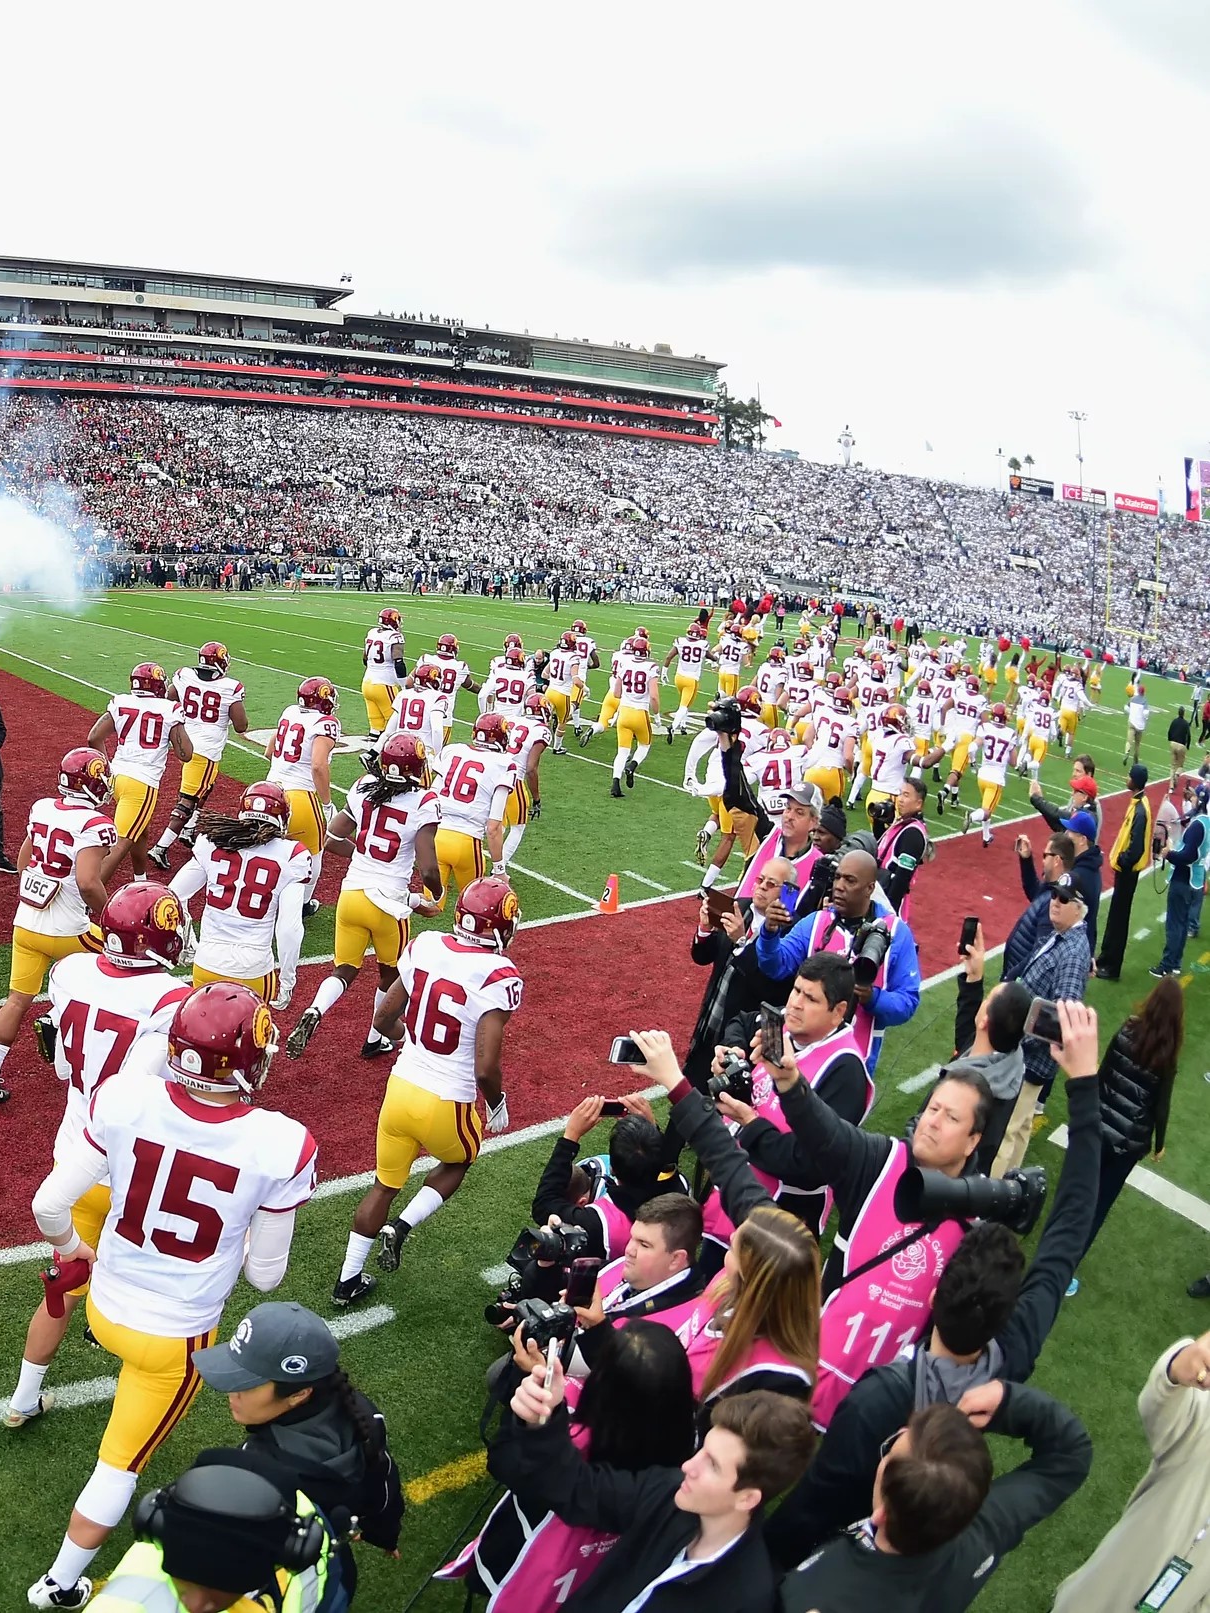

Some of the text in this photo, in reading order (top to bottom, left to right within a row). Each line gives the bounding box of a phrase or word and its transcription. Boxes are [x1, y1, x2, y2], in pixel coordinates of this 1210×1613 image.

[1064, 487, 1082, 499] ICE
[366, 638, 385, 664] 73
[681, 645, 702, 664] 89
[722, 644, 740, 662] 45
[550, 658, 565, 681] 31
[622, 669, 647, 694] 48
[183, 685, 221, 723] 68
[495, 677, 525, 704] 29
[399, 698, 425, 730] 19
[957, 701, 978, 718] 56
[1034, 711, 1051, 729] 38
[118, 707, 164, 749] 70
[273, 718, 305, 763] 93
[324, 723, 337, 738] 93
[984, 735, 1009, 763] 37
[761, 759, 793, 790] 41
[873, 750, 886, 780] 7
[439, 755, 485, 804] 16
[245, 812, 269, 821] TROJANS
[98, 827, 117, 847] 56
[356, 800, 409, 863] 15
[30, 822, 75, 879] 56
[24, 877, 49, 898] USC
[206, 847, 281, 920] 38
[602, 887, 610, 902] 2
[505, 981, 521, 1009] 16
[405, 967, 467, 1055] 16
[59, 999, 140, 1100] 47
[114, 1137, 240, 1264] 15
[904, 1226, 932, 1244] BOL
[931, 1240, 945, 1277] GAME
[879, 1298, 903, 1311] Mutual
[882, 1289, 924, 1308] Northwestern
